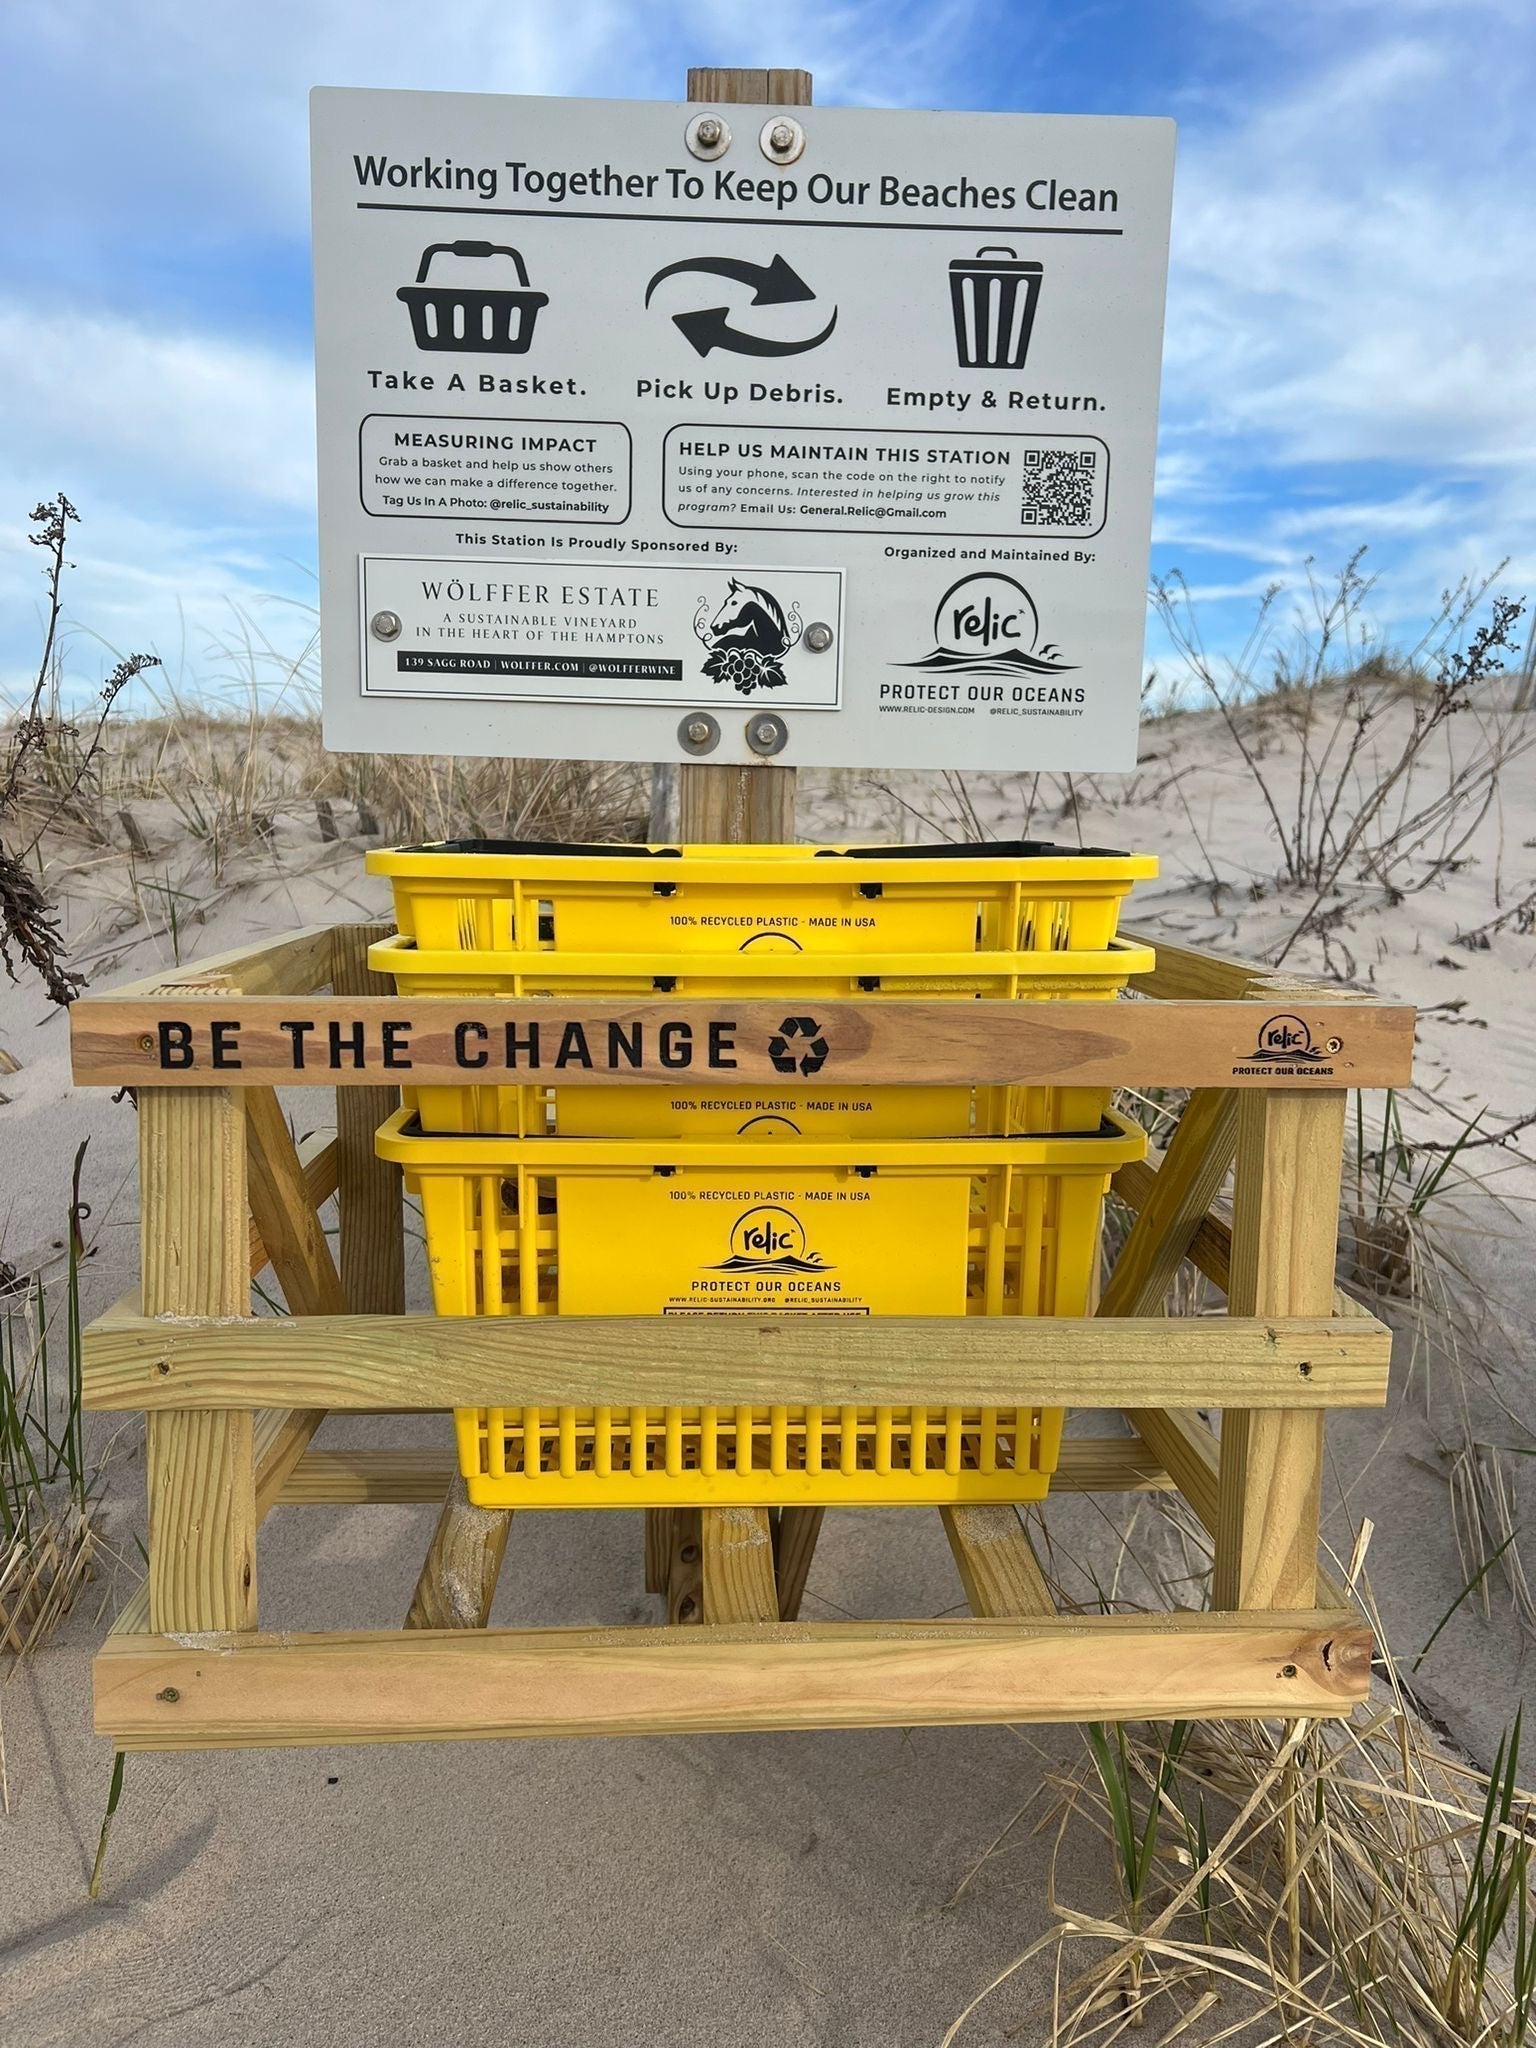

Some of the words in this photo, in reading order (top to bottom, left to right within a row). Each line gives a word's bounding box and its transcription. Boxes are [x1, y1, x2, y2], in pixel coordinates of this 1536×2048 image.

[353, 155, 496, 199] Working
[506, 162, 658, 202] Together
[666, 169, 704, 199] To
[715, 171, 797, 210] Keep
[808, 174, 870, 204] Our
[880, 176, 1015, 209] Beaches
[1026, 179, 1117, 211] Clean
[368, 371, 434, 390] Take
[448, 374, 465, 391] A
[480, 375, 585, 395] Basket.
[638, 379, 692, 399] Pick
[705, 382, 738, 404] Up
[750, 384, 842, 403] Debris.
[888, 388, 971, 411] Empty
[982, 391, 996, 408] &
[1009, 392, 1105, 411] Return.
[395, 433, 513, 449] MEASURING
[522, 437, 596, 452] IMPACT
[679, 441, 730, 457] HELP
[738, 443, 763, 458] US
[771, 445, 867, 460] MAINTAIN
[875, 447, 920, 463] THIS
[926, 449, 1010, 465] STATION
[378, 456, 409, 467] Grab
[411, 458, 419, 467] a
[422, 457, 462, 469] basket
[465, 459, 489, 470] and
[492, 459, 519, 473] help
[522, 463, 537, 471] us
[539, 461, 572, 472] show
[574, 462, 613, 474] others
[375, 473, 401, 485] how
[403, 477, 422, 486] we
[424, 477, 447, 486] can
[450, 477, 484, 488] make
[486, 479, 494, 488] a
[496, 478, 559, 490] difference
[561, 481, 617, 493] together.
[678, 465, 713, 479] Using
[716, 469, 743, 479] your
[746, 467, 788, 480] phone,
[791, 471, 819, 480] scan
[822, 470, 843, 481] the
[846, 471, 876, 482] code
[878, 473, 894, 482] on
[897, 472, 918, 483] the
[921, 472, 951, 485] right
[954, 474, 967, 484] to
[970, 474, 1006, 487] notify
[678, 485, 692, 493] us
[695, 483, 708, 494] of
[711, 486, 733, 496] any
[735, 486, 794, 496] concerns.
[796, 487, 859, 498] Interested
[861, 488, 874, 498] in
[876, 488, 923, 502] helping
[926, 492, 941, 501] us
[943, 492, 975, 503] grow
[977, 491, 1001, 502] this
[382, 495, 404, 508] Tag
[406, 496, 422, 506] Us
[424, 496, 436, 507] In
[438, 497, 448, 507] A
[449, 497, 488, 508] Photo:
[489, 498, 610, 514] @relic_sustainability
[677, 503, 737, 514] program?
[740, 503, 774, 514] Email
[777, 504, 796, 514] Us:
[799, 504, 947, 519] General.Relic@Gmail.com
[455, 532, 487, 545] This
[491, 534, 546, 547] Station
[551, 536, 564, 548] Is
[568, 537, 627, 552] Proudly
[631, 539, 710, 553] Sponsored
[715, 541, 738, 556] By:
[884, 546, 956, 560] Organized
[960, 548, 987, 560] and
[991, 548, 1070, 562] Maintained
[1074, 551, 1096, 565] By:
[422, 579, 548, 603] WÖLFFER
[563, 587, 658, 606] ESTATE
[443, 612, 452, 623] A
[458, 613, 558, 626] SUSTAINABLE
[563, 616, 637, 629] VINEYARD
[954, 597, 1021, 646] relic
[416, 626, 431, 637] IN
[436, 627, 467, 638] THE
[471, 628, 521, 640] HEART
[525, 630, 544, 641] OF
[549, 631, 580, 642] THE
[584, 632, 664, 645] HAMPTONS
[404, 656, 425, 668] 139
[426, 657, 457, 669] SAGG
[458, 658, 492, 670] ROAD
[500, 660, 580, 672] WOLFFER.COM
[587, 662, 677, 676] @WOLFFERWINE
[880, 684, 960, 700] PROTECT
[968, 686, 1003, 701] OUR
[1013, 687, 1084, 702] OCEANS
[878, 705, 975, 715] WWW.RELIC-DESIGN.COM
[989, 707, 1084, 717] @RELIC_SUSTAINABILITY
[670, 915, 698, 926] 100%
[700, 916, 753, 927] RECYCLED
[756, 916, 799, 927] PLASTIC
[808, 917, 838, 927] MADE
[841, 917, 852, 927] IN
[854, 917, 876, 928] USA
[158, 1022, 242, 1069] BE
[280, 1022, 412, 1069] THE
[455, 1022, 737, 1068] CHANGE
[1268, 1026, 1302, 1048] relic
[1231, 1066, 1273, 1075] PROTECT
[1274, 1067, 1295, 1076] OUR
[1296, 1067, 1334, 1076] OCEANS
[670, 1100, 698, 1110] 100%
[700, 1100, 752, 1110] RECYCLED
[755, 1100, 797, 1111] PLASTIC
[806, 1101, 835, 1111] MADE
[838, 1101, 849, 1111] IN
[851, 1102, 873, 1112] USA
[669, 1190, 697, 1201] 100%
[699, 1190, 751, 1201] RECYCLED
[753, 1190, 795, 1201] PLASTIC
[804, 1191, 833, 1201] MADE
[836, 1191, 847, 1201] IN
[849, 1191, 871, 1201] USA
[744, 1222, 793, 1254] relic
[691, 1281, 751, 1292] PROTECT
[755, 1281, 782, 1292] OUR
[788, 1281, 841, 1292] OCEANS
[784, 1296, 863, 1304] @RELIC_SUSTAINABILITY
